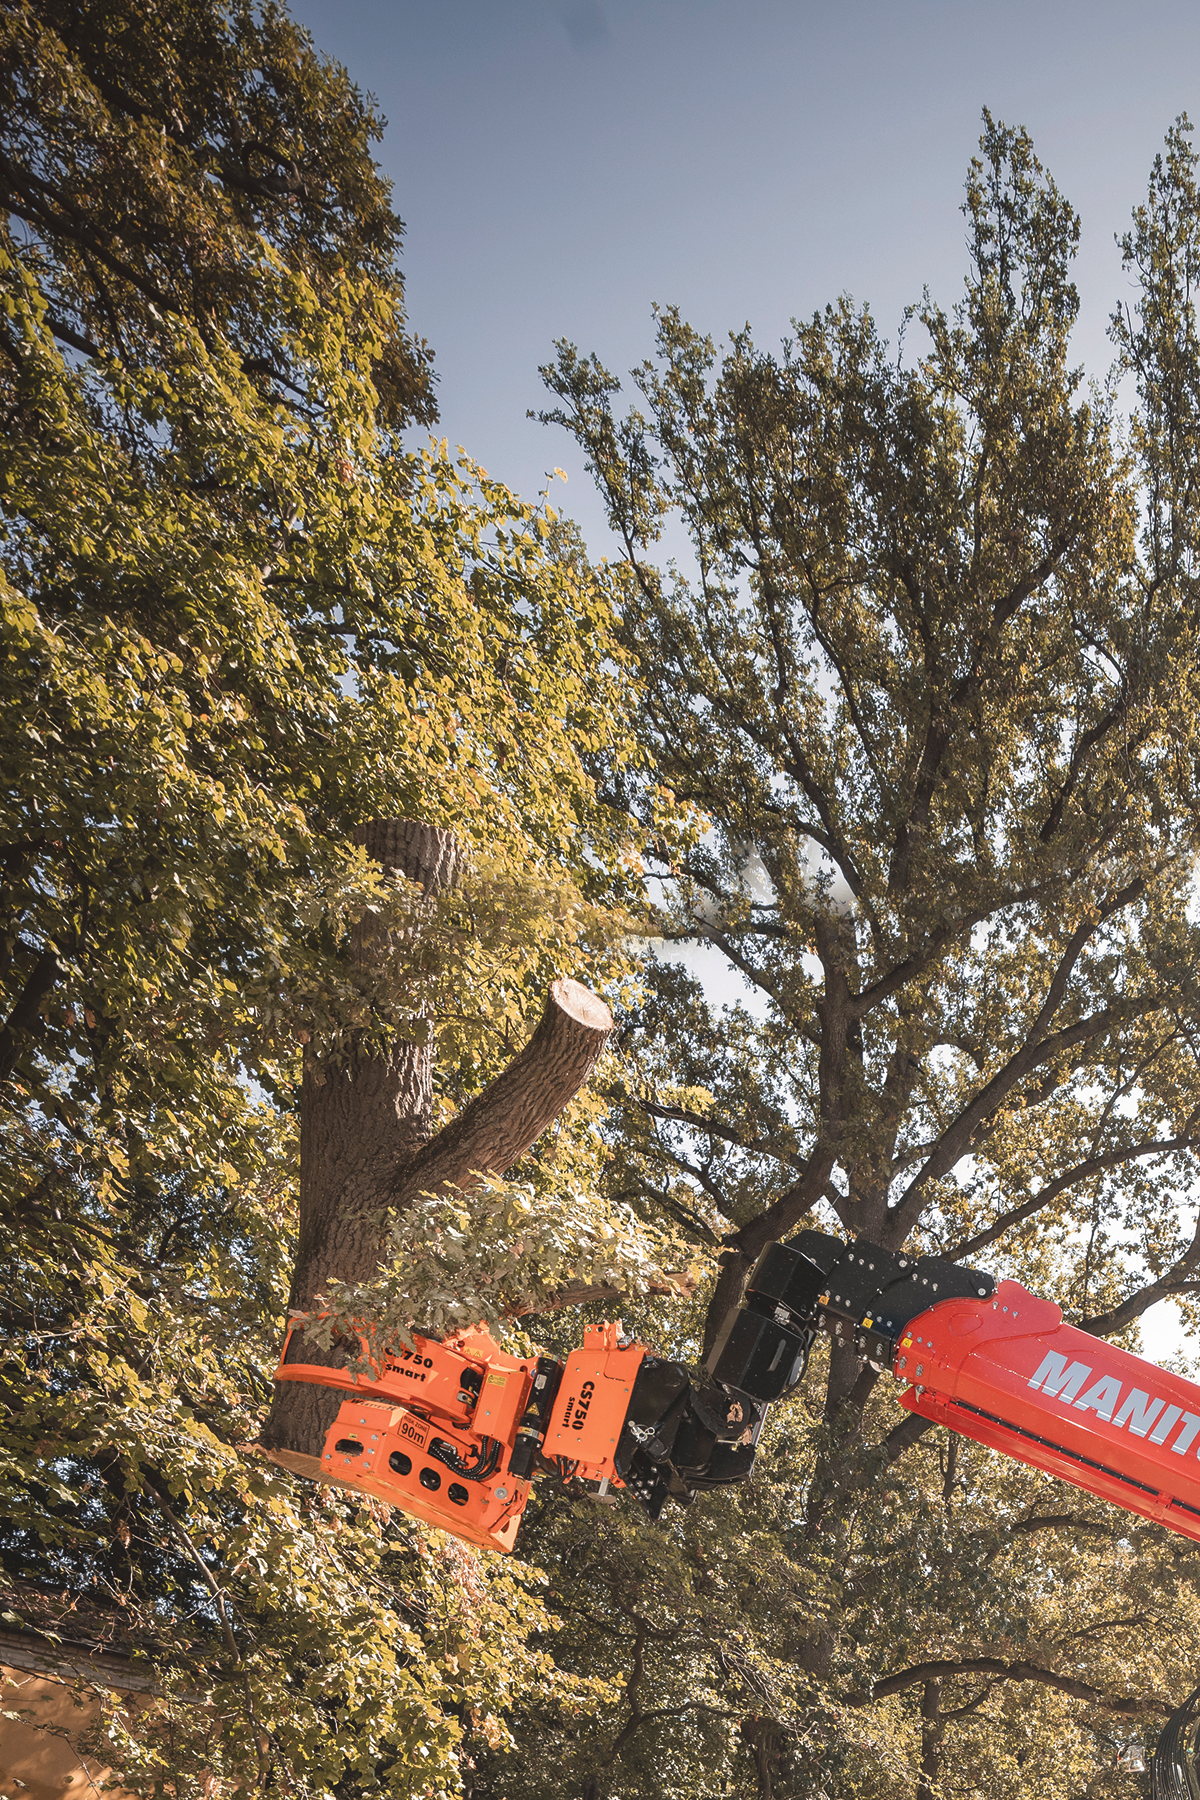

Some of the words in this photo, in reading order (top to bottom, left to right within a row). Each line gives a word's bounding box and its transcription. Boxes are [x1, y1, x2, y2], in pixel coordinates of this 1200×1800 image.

[384, 1347, 433, 1368] C750
[385, 1363, 426, 1382] smart
[562, 1396, 576, 1428] smart
[571, 1381, 595, 1430] CS750
[401, 1422, 424, 1445] 90m
[415, 1421, 428, 1433] ZONE
